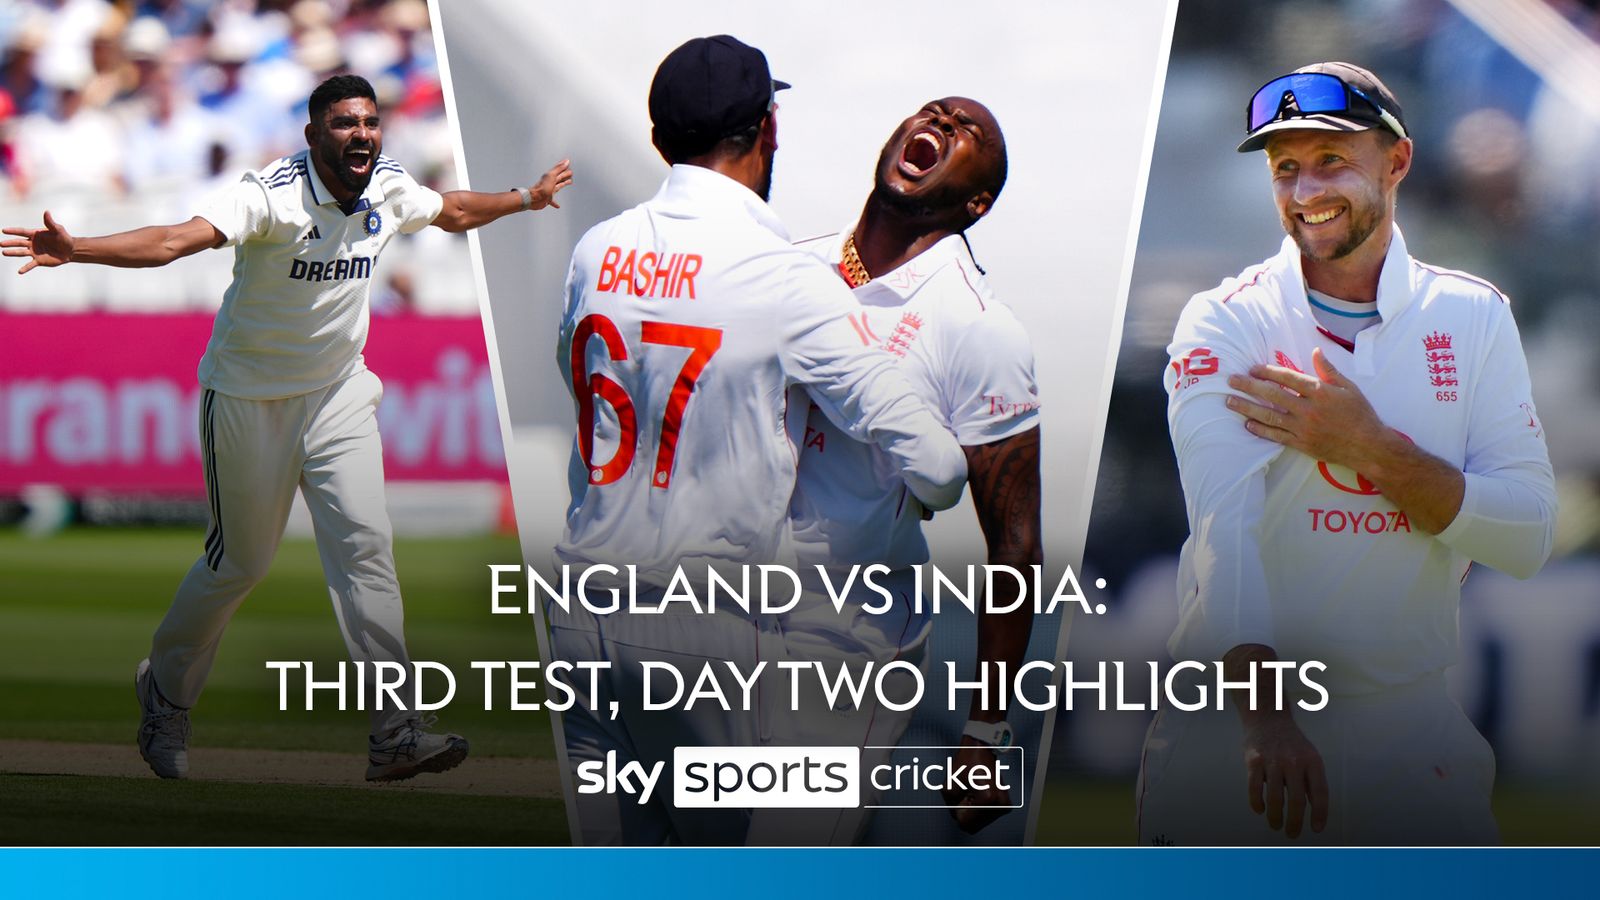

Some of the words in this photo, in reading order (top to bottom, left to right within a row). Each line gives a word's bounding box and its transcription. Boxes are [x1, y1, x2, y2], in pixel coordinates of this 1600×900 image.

[597, 246, 703, 299] BASHIR
[571, 314, 723, 489] 67
[1436, 391, 1458, 402] 655
[1308, 509, 1412, 534] TOYOTA
